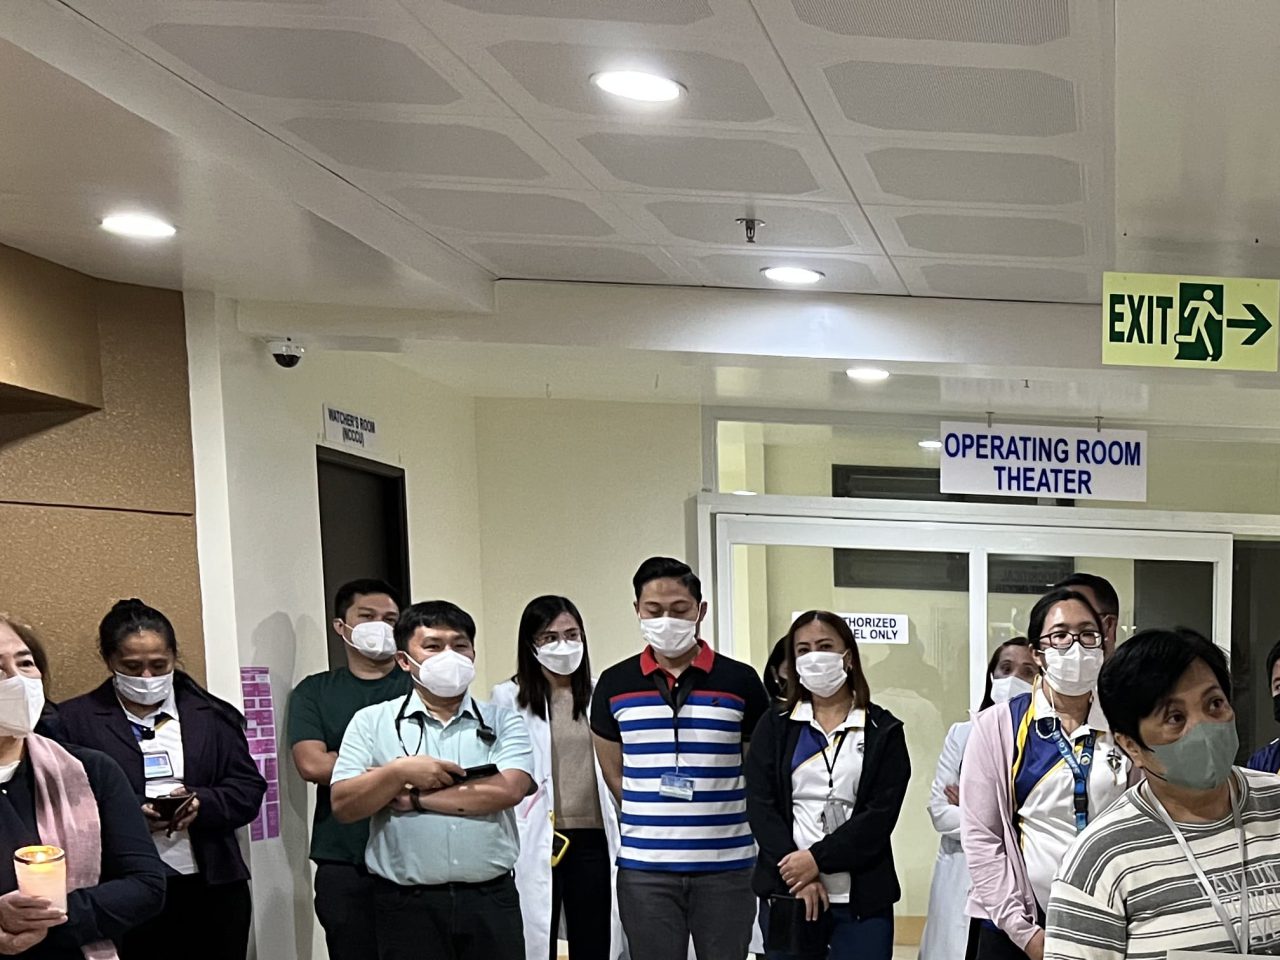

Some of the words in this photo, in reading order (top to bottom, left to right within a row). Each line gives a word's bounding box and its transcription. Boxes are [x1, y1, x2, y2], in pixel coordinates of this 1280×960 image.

[1109, 293, 1174, 345] EXIT
[327, 407, 360, 430] WATCHER'S
[359, 417, 376, 434] ROOM
[944, 432, 1070, 464] OPERATING
[1076, 439, 1141, 466] ROOM
[993, 466, 1093, 495] THEATER
[869, 629, 898, 640] ONLY
